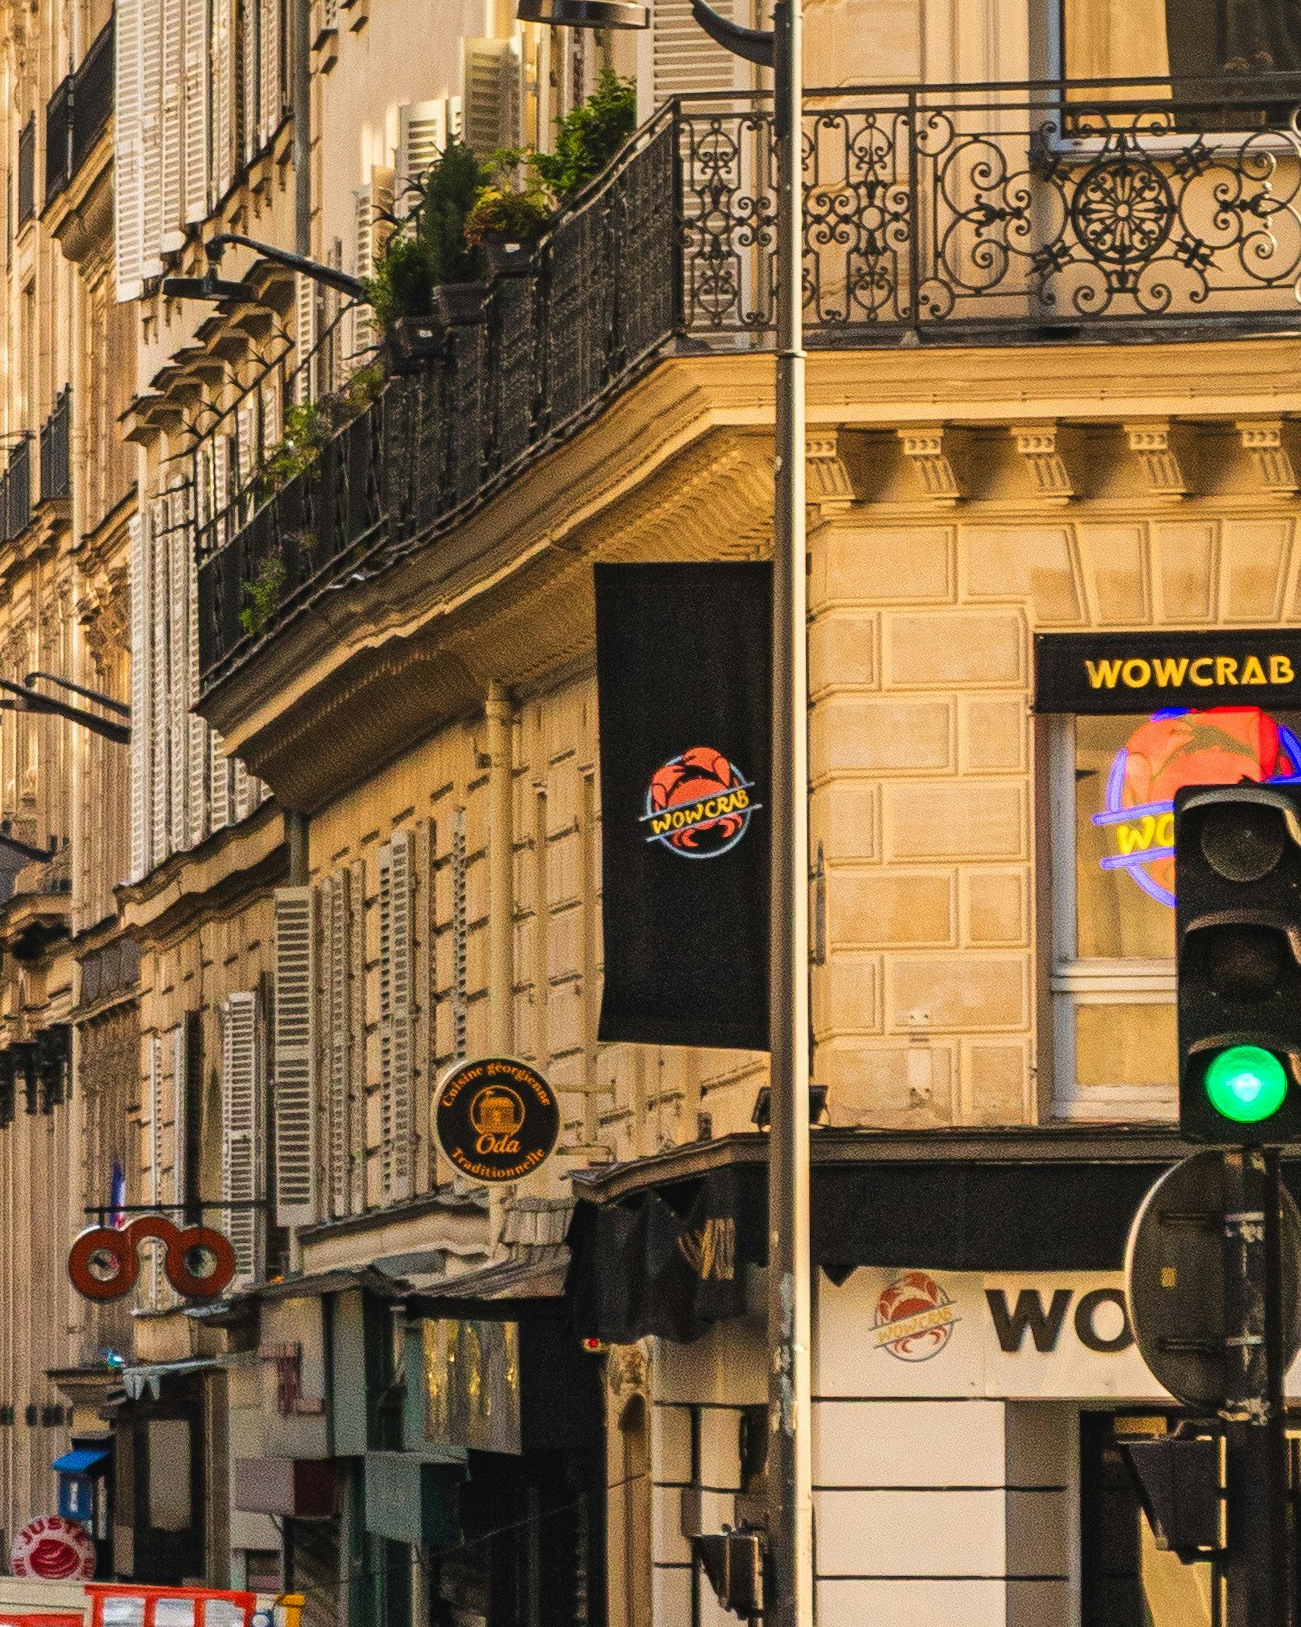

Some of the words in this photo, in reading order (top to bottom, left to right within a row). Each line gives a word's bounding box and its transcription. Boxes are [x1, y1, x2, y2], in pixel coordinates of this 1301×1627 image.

[1085, 655, 1295, 688] WOWCRAB
[651, 789, 749, 834] WOWCRAB
[1117, 812, 1175, 854] WO
[476, 1132, 521, 1155] Oda
[984, 1288, 1138, 1354] WO
